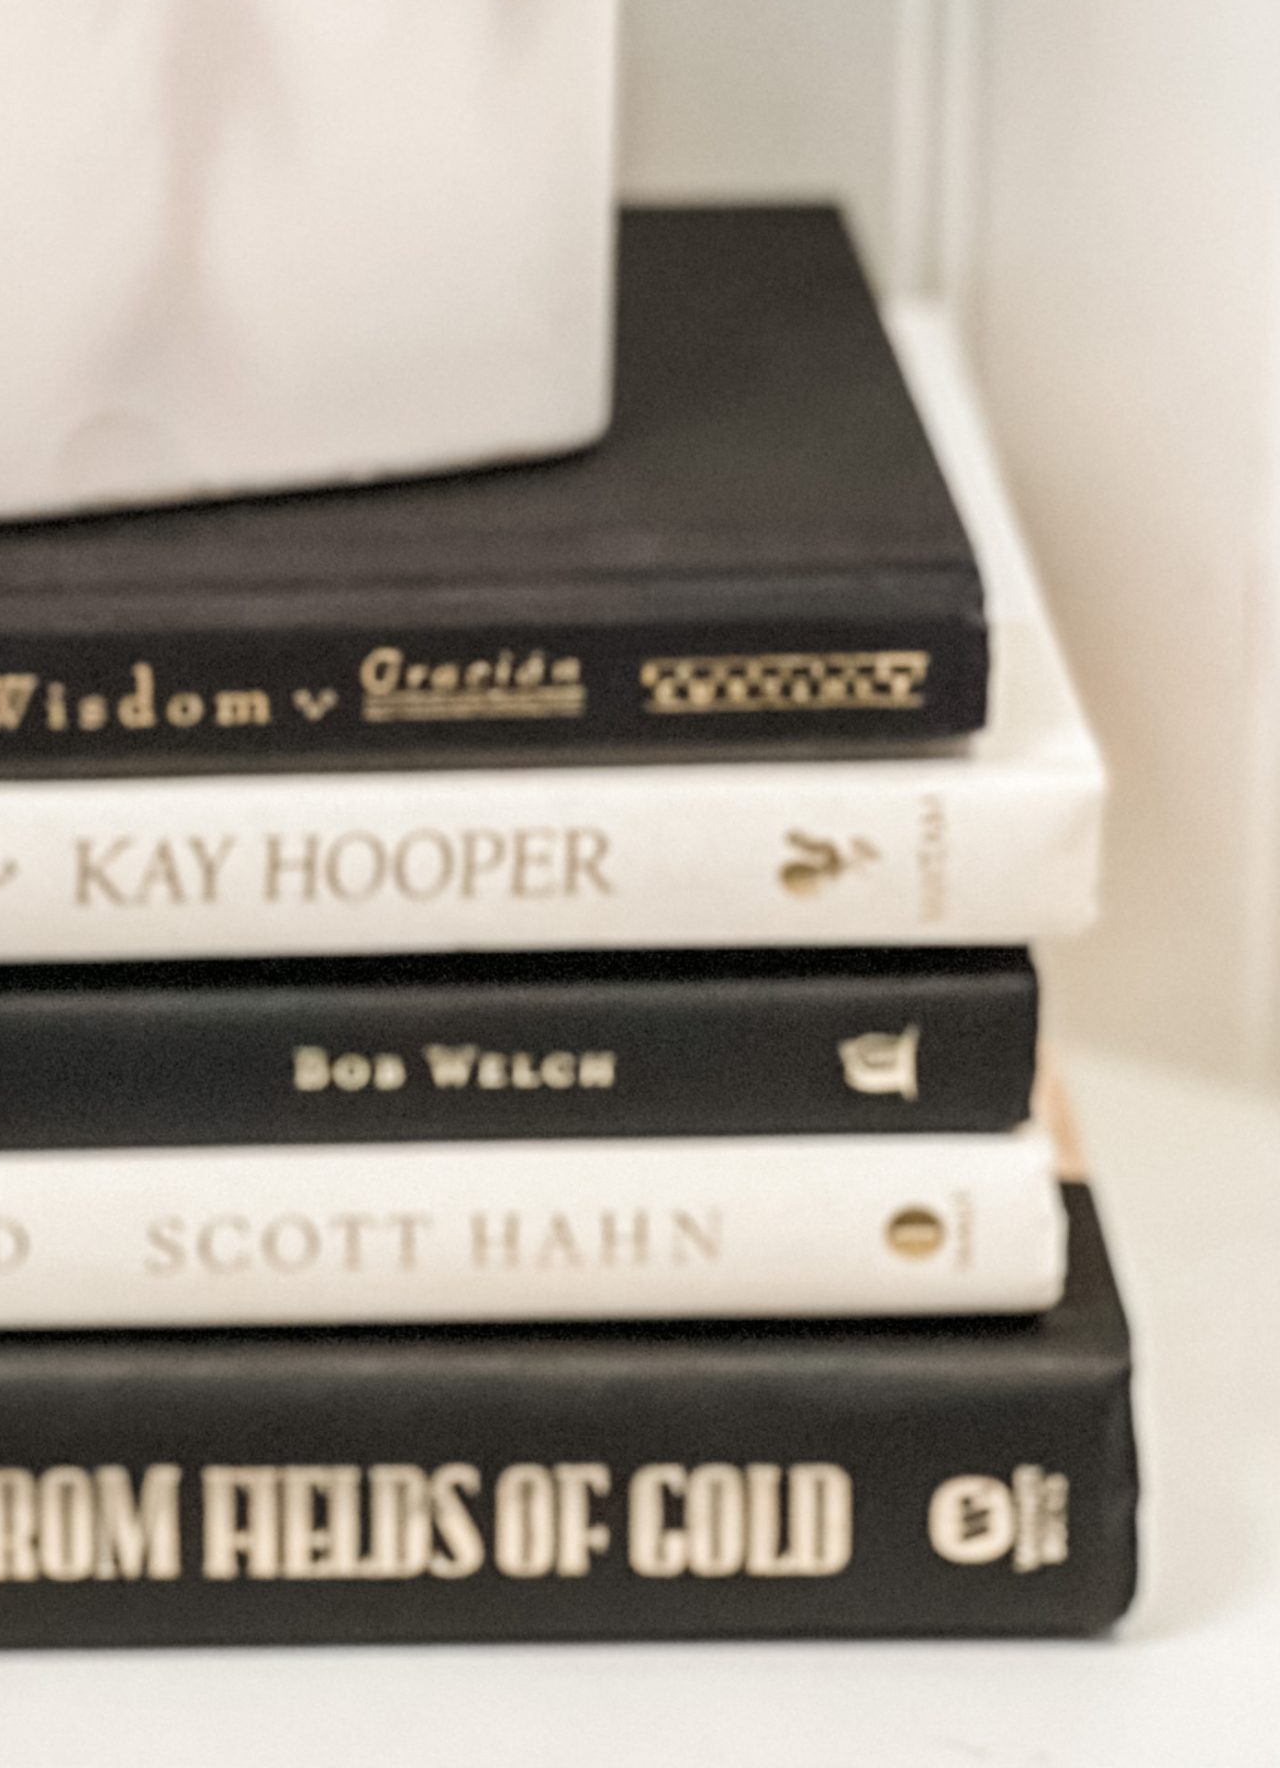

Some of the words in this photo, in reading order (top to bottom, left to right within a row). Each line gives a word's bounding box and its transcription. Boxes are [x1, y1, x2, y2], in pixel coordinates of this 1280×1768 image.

[74, 835, 234, 908] KAY
[263, 827, 615, 903] HOOPER
[146, 1212, 431, 1276] SCOTT
[470, 1208, 725, 1272] HAHN
[203, 1463, 484, 1579] FIELDS
[495, 1463, 610, 1577] OF
[629, 1463, 852, 1577] GOLD
